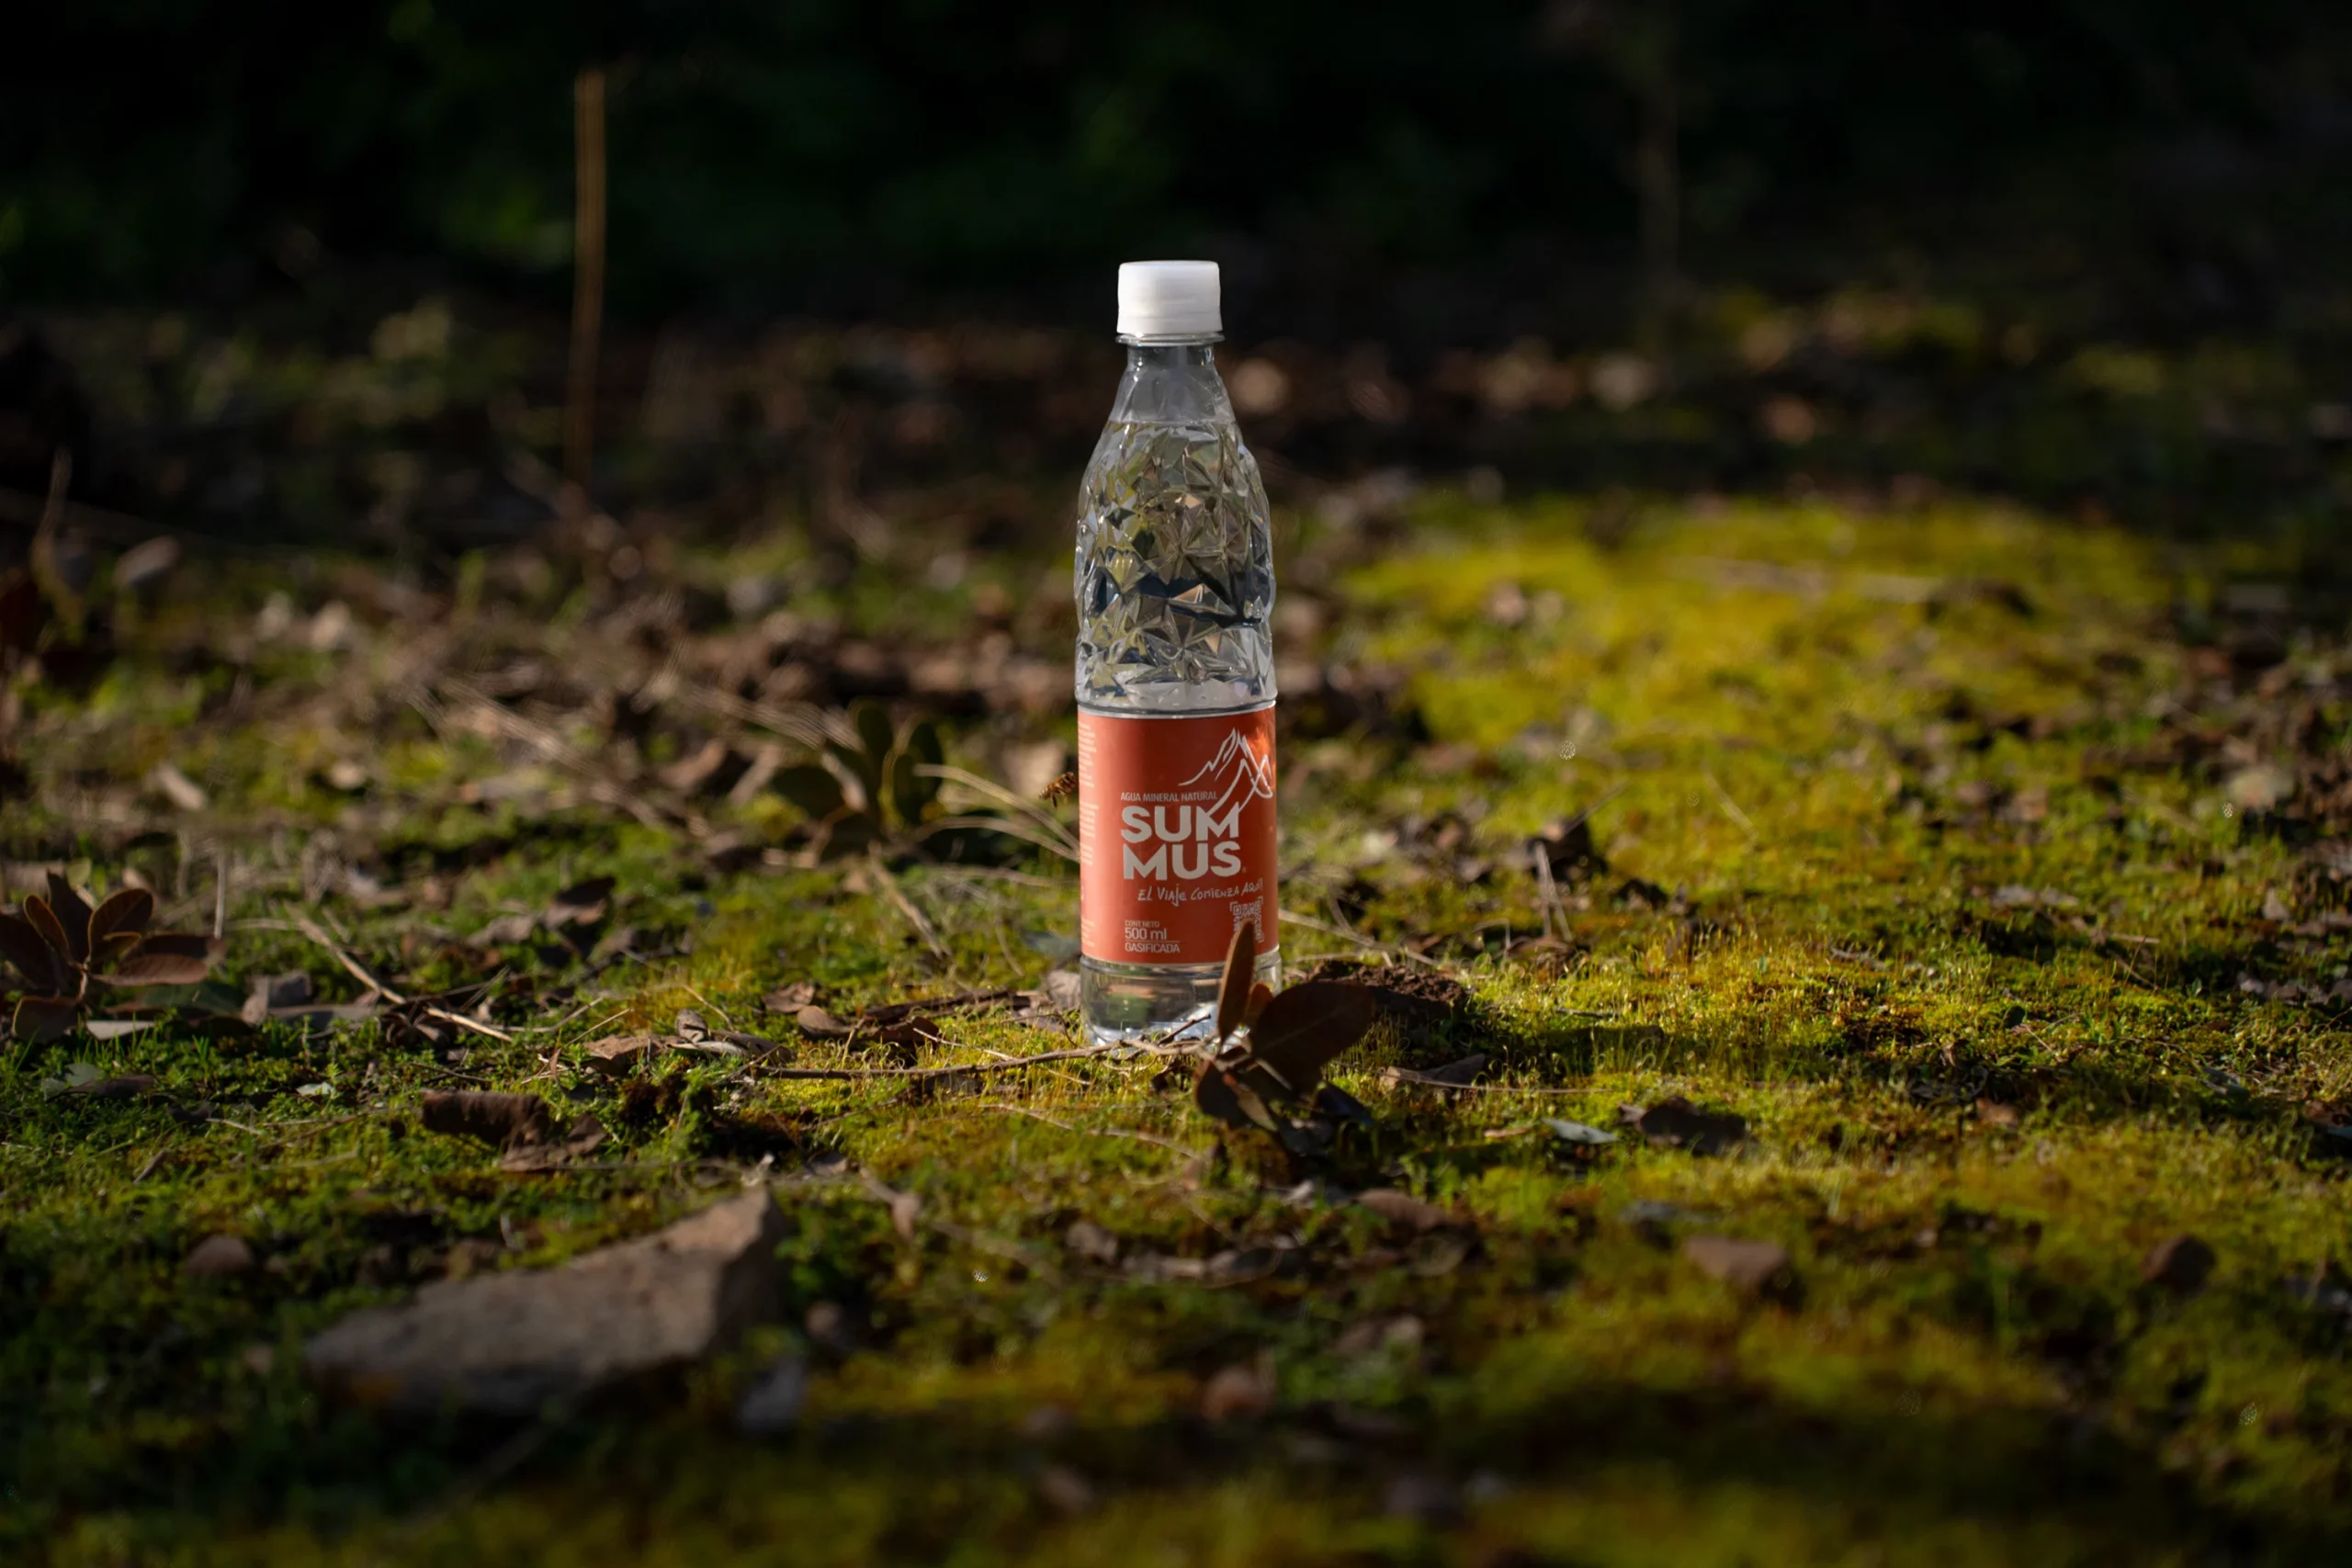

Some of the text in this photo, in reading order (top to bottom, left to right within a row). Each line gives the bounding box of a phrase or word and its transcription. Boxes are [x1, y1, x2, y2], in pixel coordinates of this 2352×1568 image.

[1121, 791, 1217, 802] AGUA MINERAL NATURAL
[1121, 802, 1239, 843] SUM
[1123, 840, 1241, 880] MUS
[1137, 886, 1152, 901] EL
[1125, 928, 1167, 940] 500 ml
[1125, 942, 1181, 953] GASIFICADA
